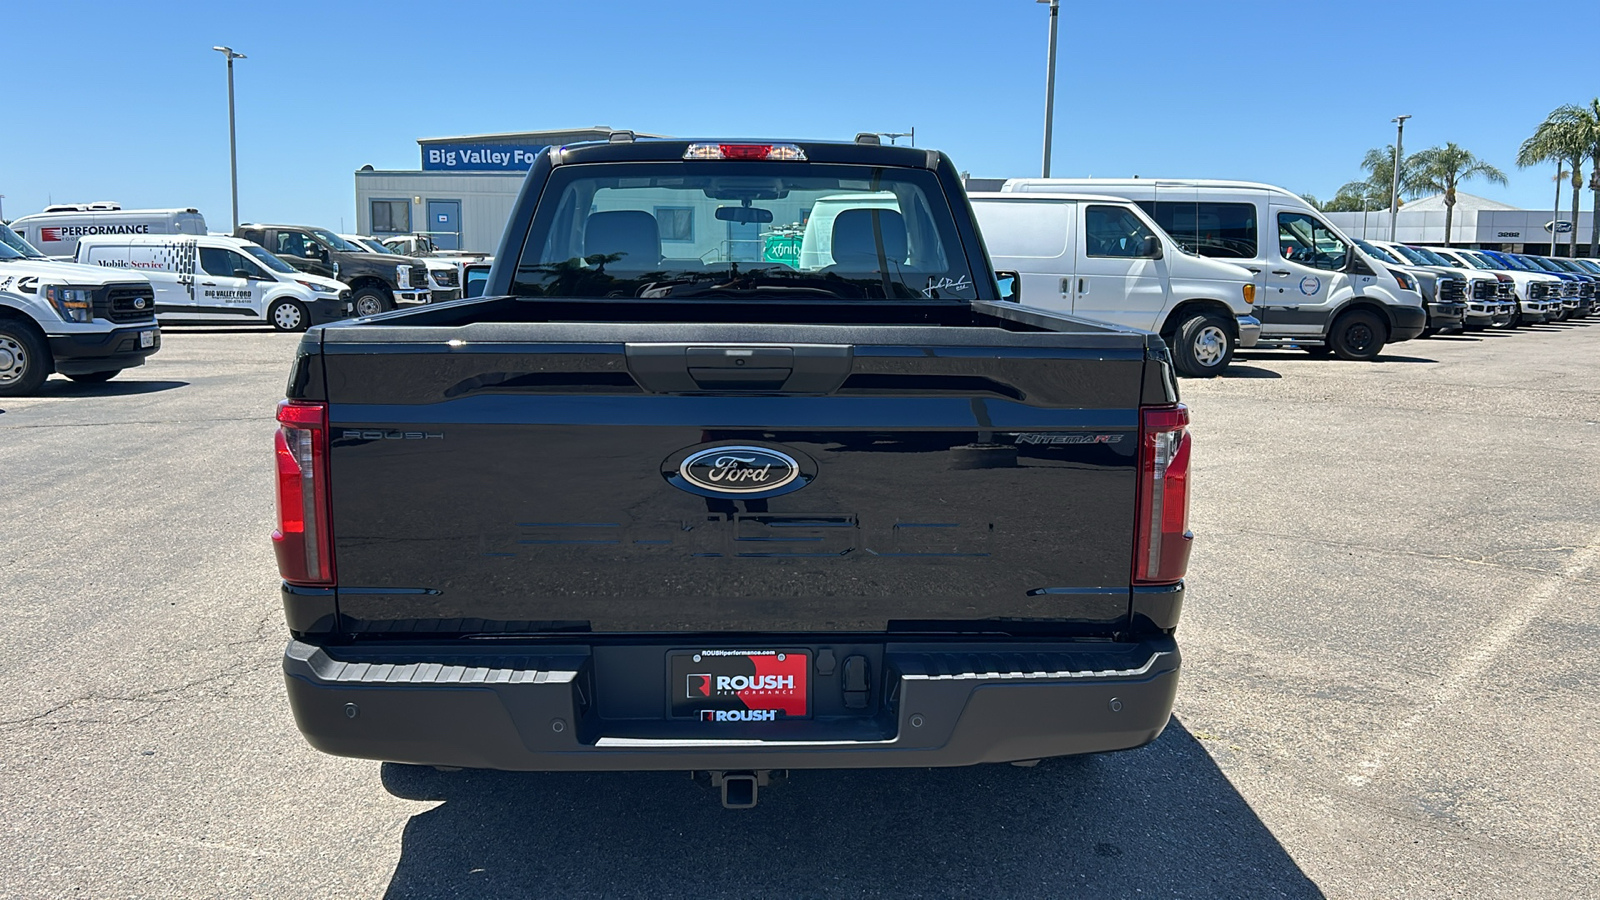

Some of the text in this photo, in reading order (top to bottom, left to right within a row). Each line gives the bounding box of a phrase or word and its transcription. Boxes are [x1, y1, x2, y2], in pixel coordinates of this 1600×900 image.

[429, 150, 539, 166] Big Valley Fo
[61, 225, 148, 236] PERFORMANCE
[772, 242, 801, 258] xfinity
[98, 260, 163, 269] Mobile Service
[343, 430, 444, 440] ROUSH
[708, 455, 771, 482] Ford
[717, 675, 794, 690] ROUSH
[716, 709, 777, 722] ROUSH
